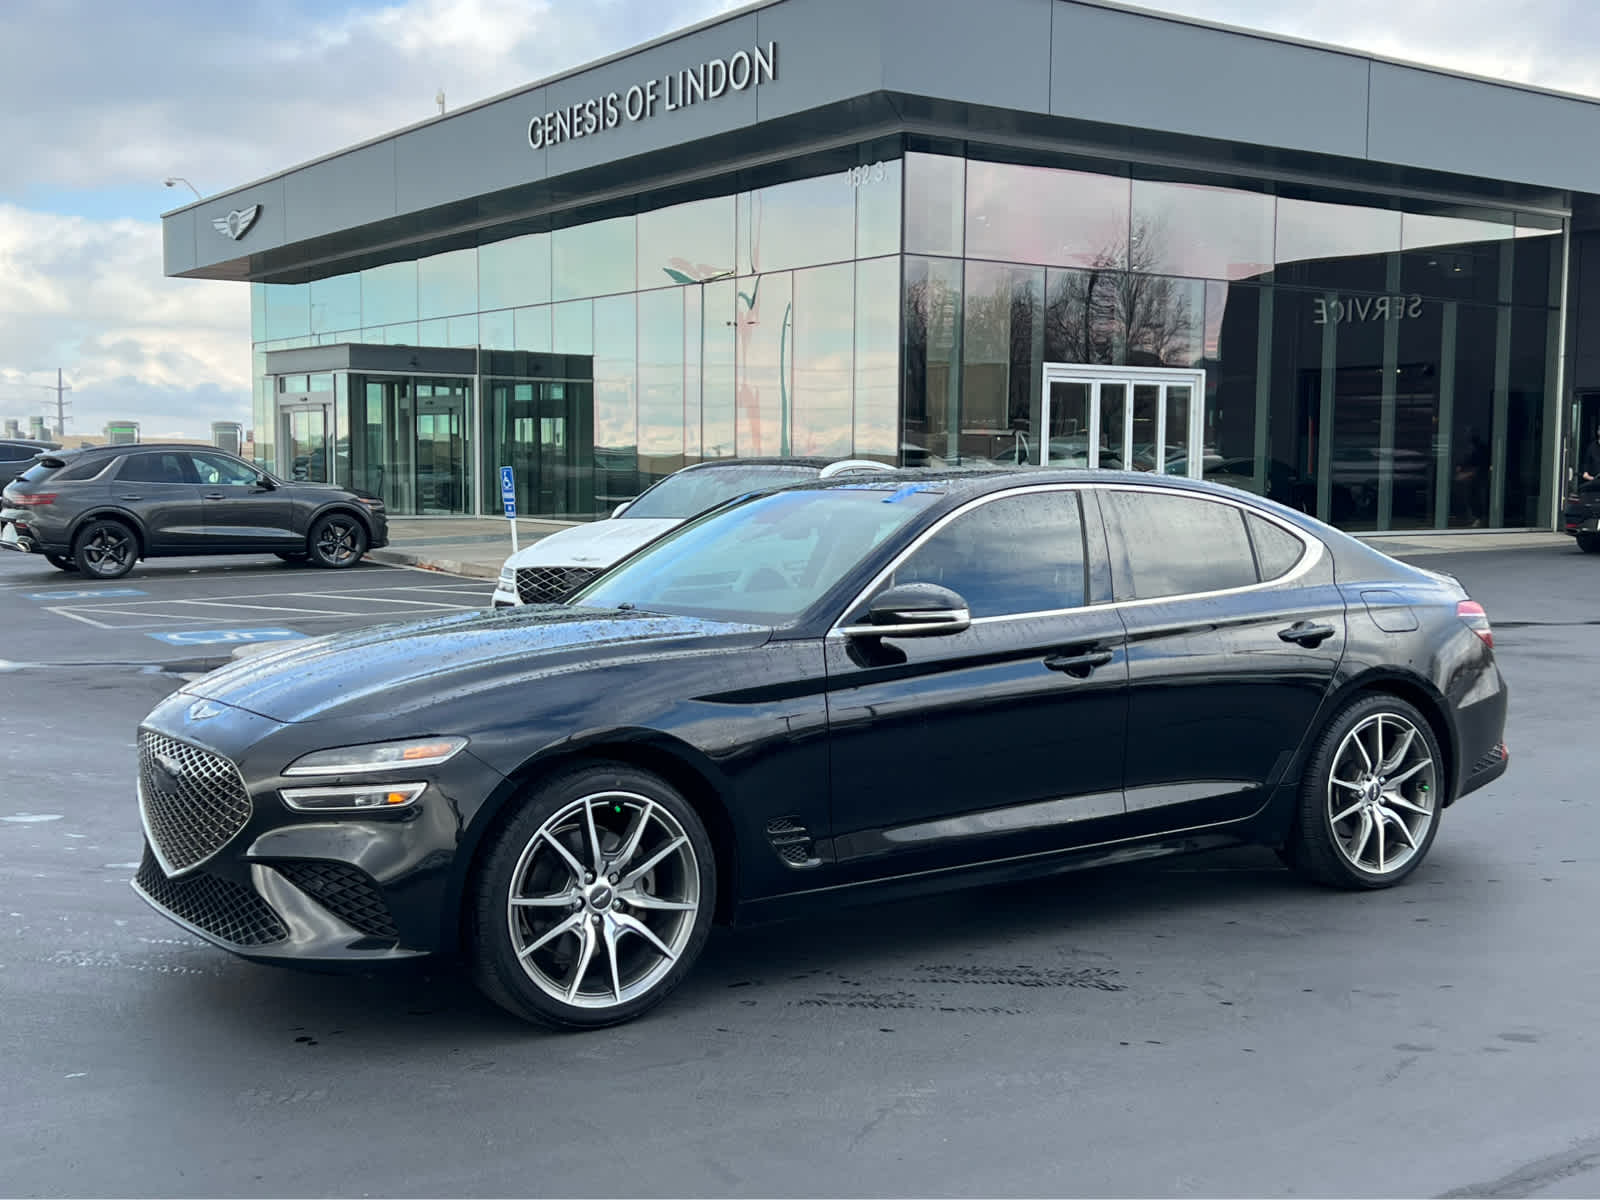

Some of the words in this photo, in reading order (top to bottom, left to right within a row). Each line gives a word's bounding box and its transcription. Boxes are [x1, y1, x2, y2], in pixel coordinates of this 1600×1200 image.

[528, 92, 618, 149] GENESIS
[625, 80, 658, 121] OF
[665, 41, 776, 111] LINDON
